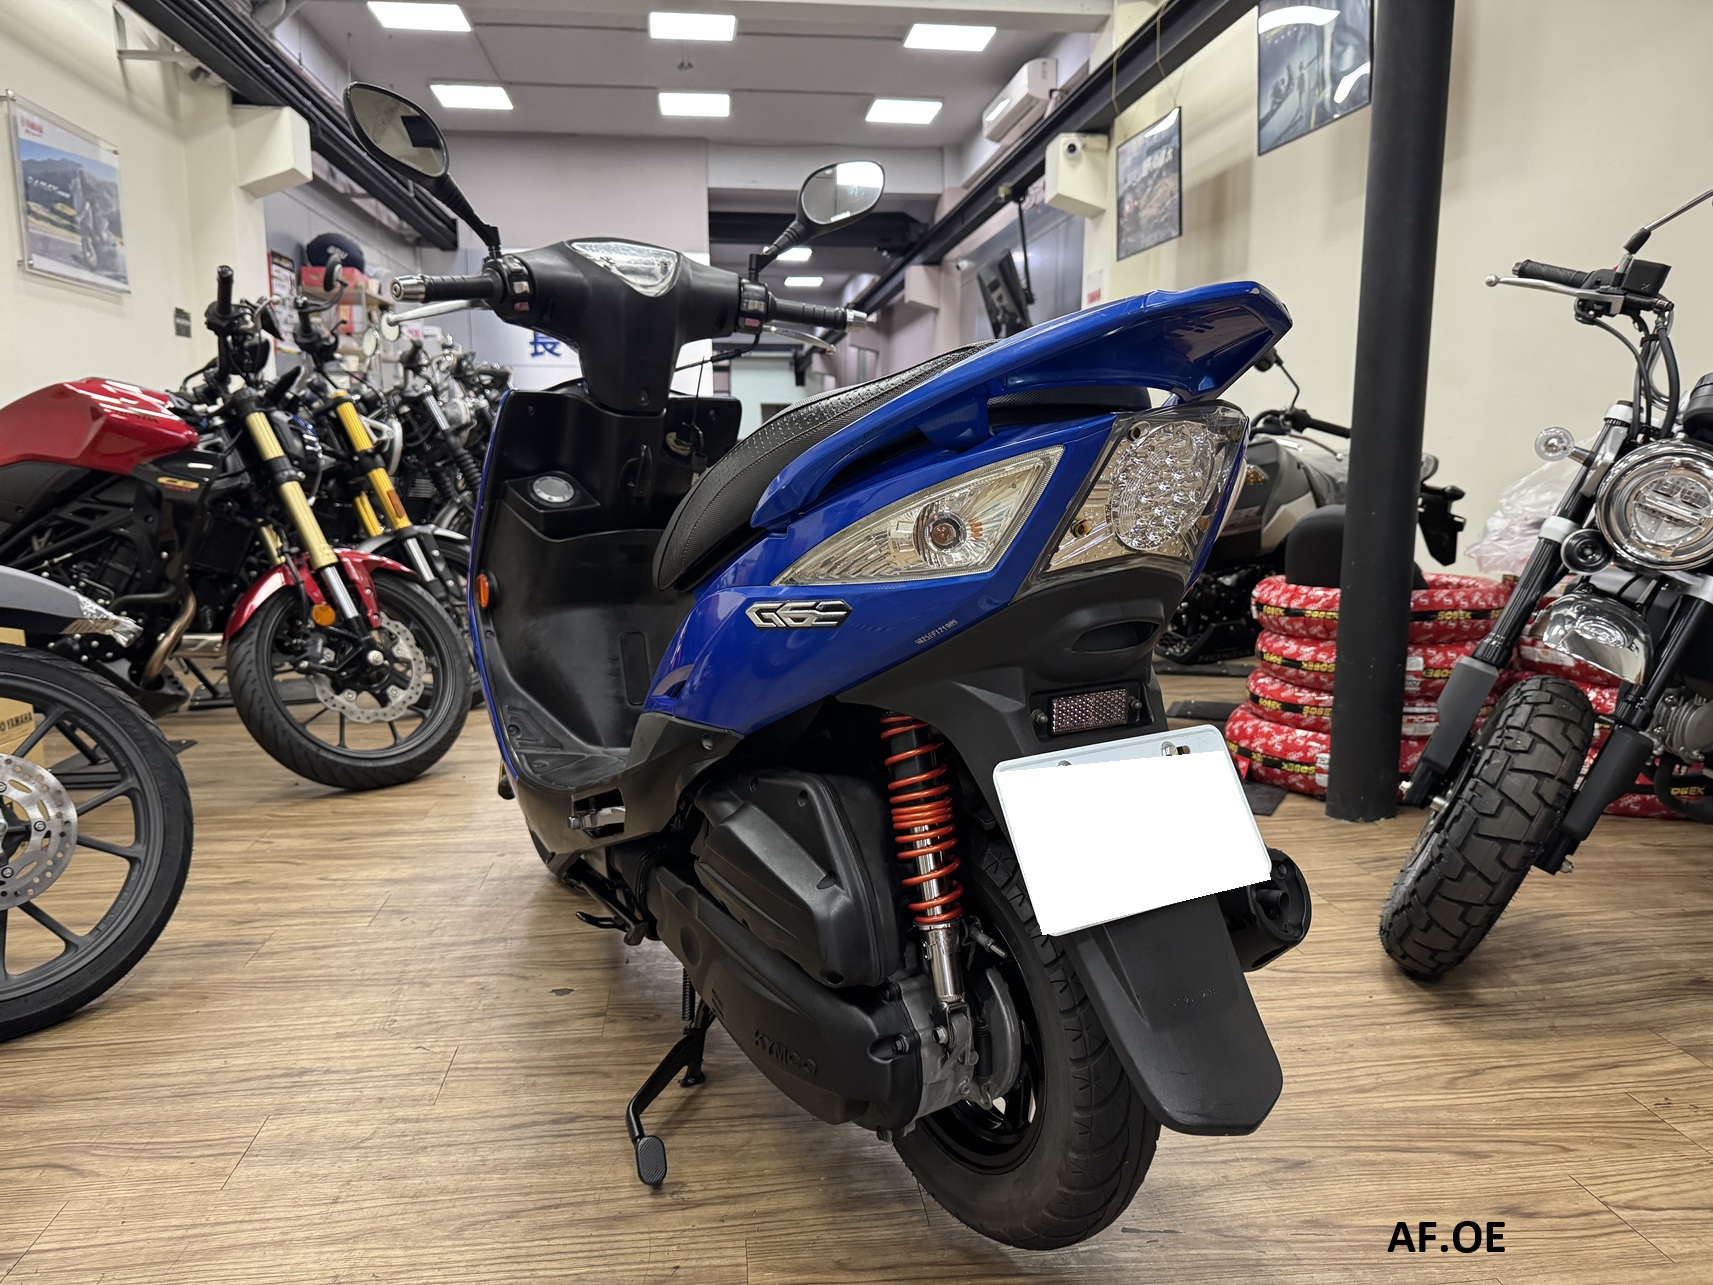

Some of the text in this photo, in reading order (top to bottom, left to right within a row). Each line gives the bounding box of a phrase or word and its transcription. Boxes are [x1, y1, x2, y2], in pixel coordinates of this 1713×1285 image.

[1437, 610, 1472, 620] SOBEK
[1302, 661, 1336, 672] SOBEK
[1303, 705, 1333, 717] SOBE
[1282, 762, 1316, 775] SOBEK
[1671, 786, 1704, 796] OBEK
